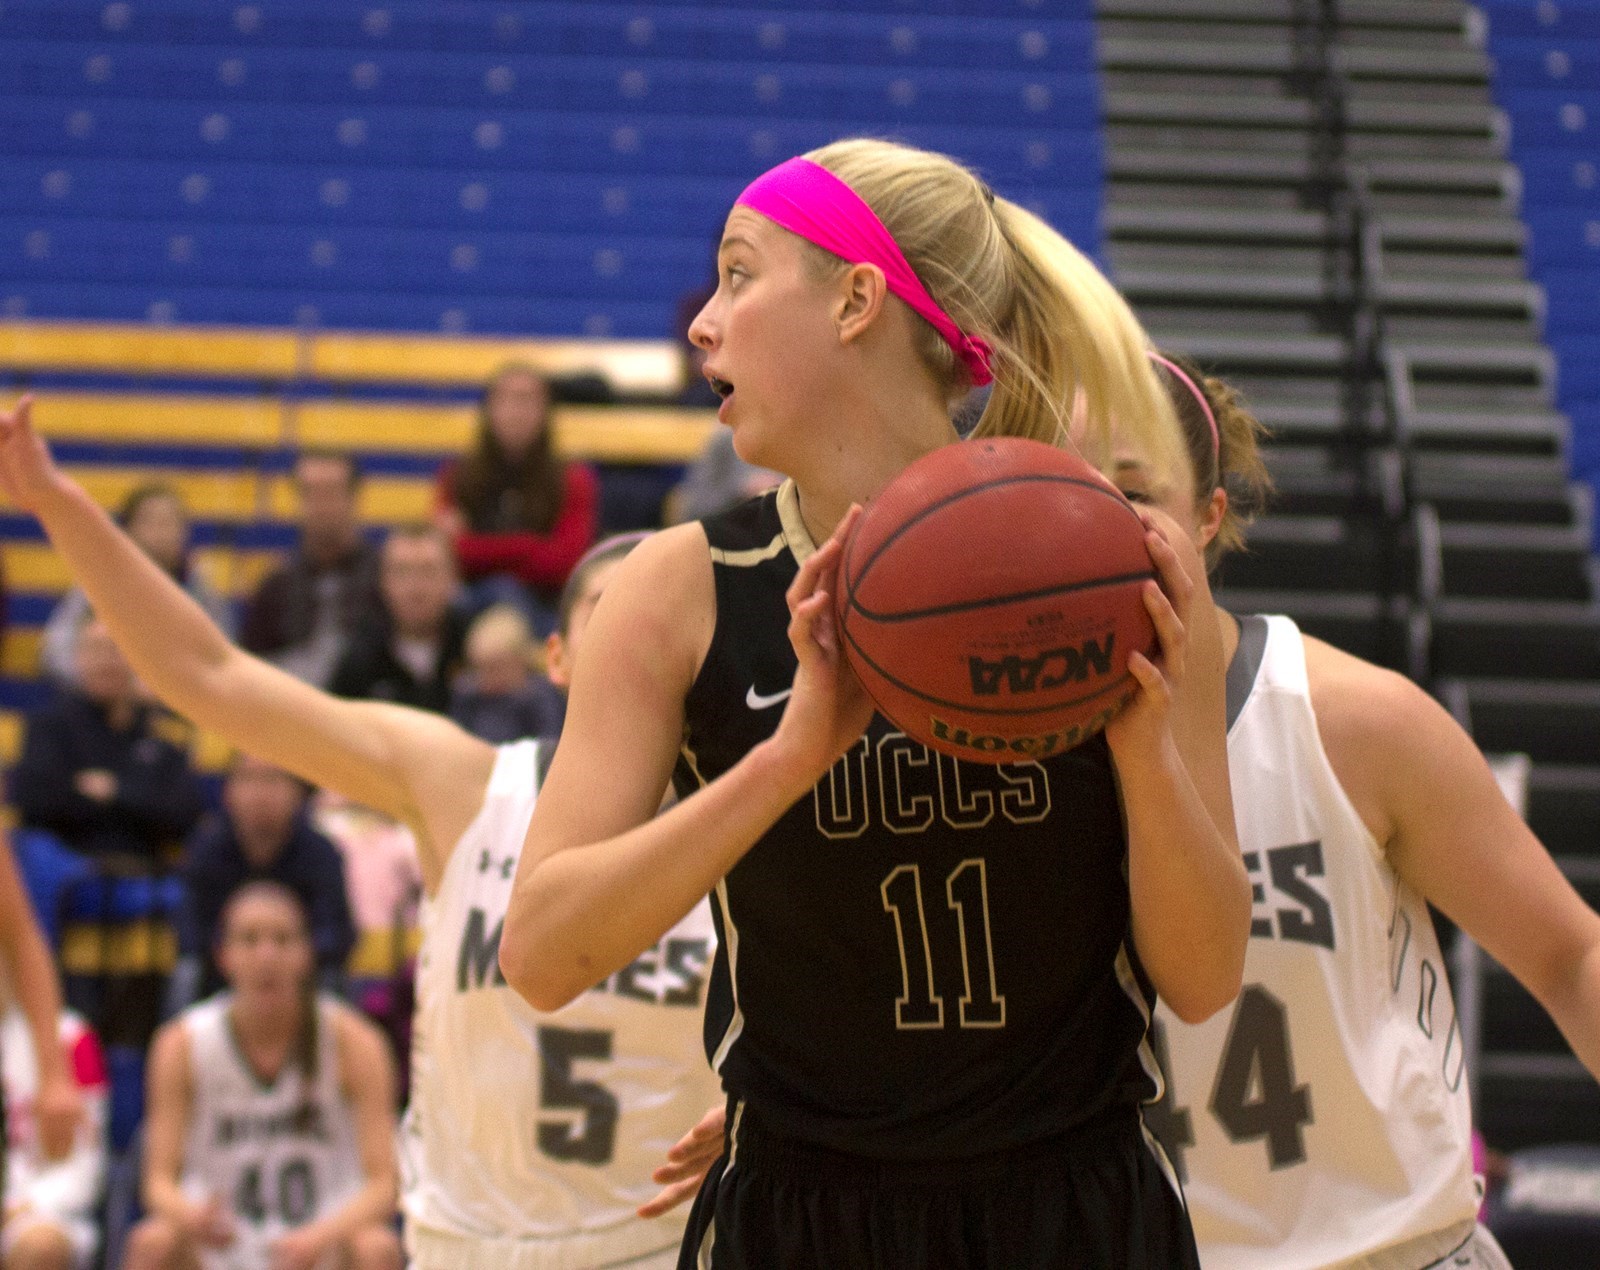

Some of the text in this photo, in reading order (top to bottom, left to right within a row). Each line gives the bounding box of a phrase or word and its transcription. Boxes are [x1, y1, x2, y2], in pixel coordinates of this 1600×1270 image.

[969, 632, 1115, 695] NCAA
[457, 905, 708, 1008] MES
[880, 858, 1006, 1030] 11
[536, 1023, 621, 1166] 5
[233, 1155, 319, 1230] 40
